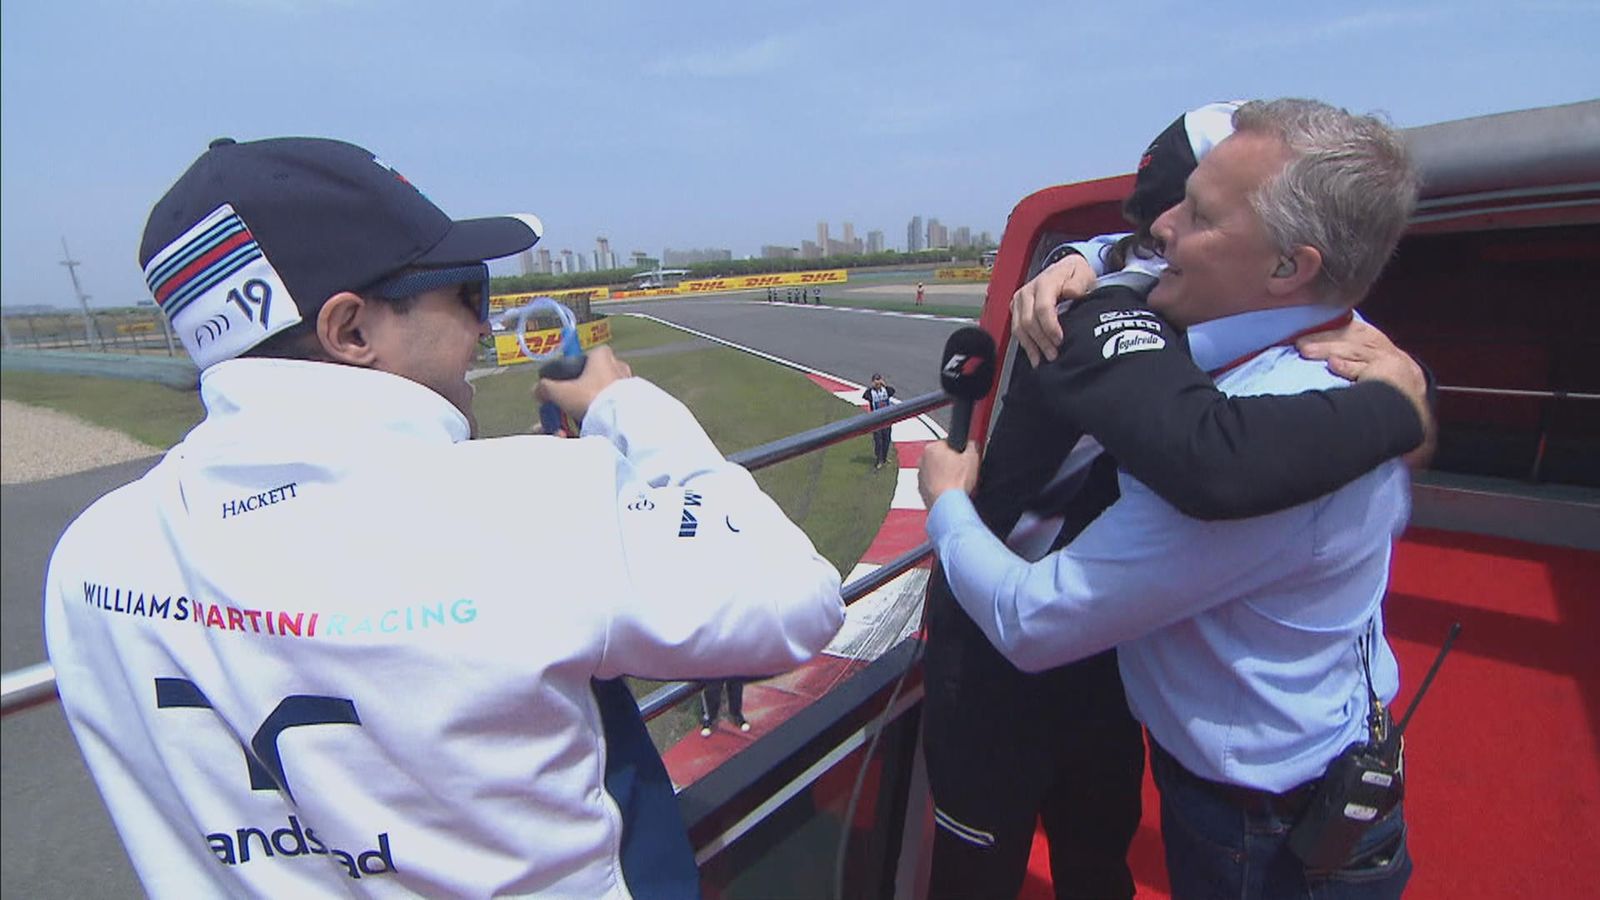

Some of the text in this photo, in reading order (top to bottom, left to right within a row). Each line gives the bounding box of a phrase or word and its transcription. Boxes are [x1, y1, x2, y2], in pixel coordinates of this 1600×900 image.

[688, 281, 727, 291] DHL
[745, 276, 784, 287] DHL
[800, 272, 838, 283] DHL
[226, 277, 273, 330] 19
[516, 333, 564, 358] DH
[221, 482, 298, 518] HACKETT
[83, 581, 478, 637] WILLIAMS MARTINI RACING
[206, 815, 399, 879] andsad
